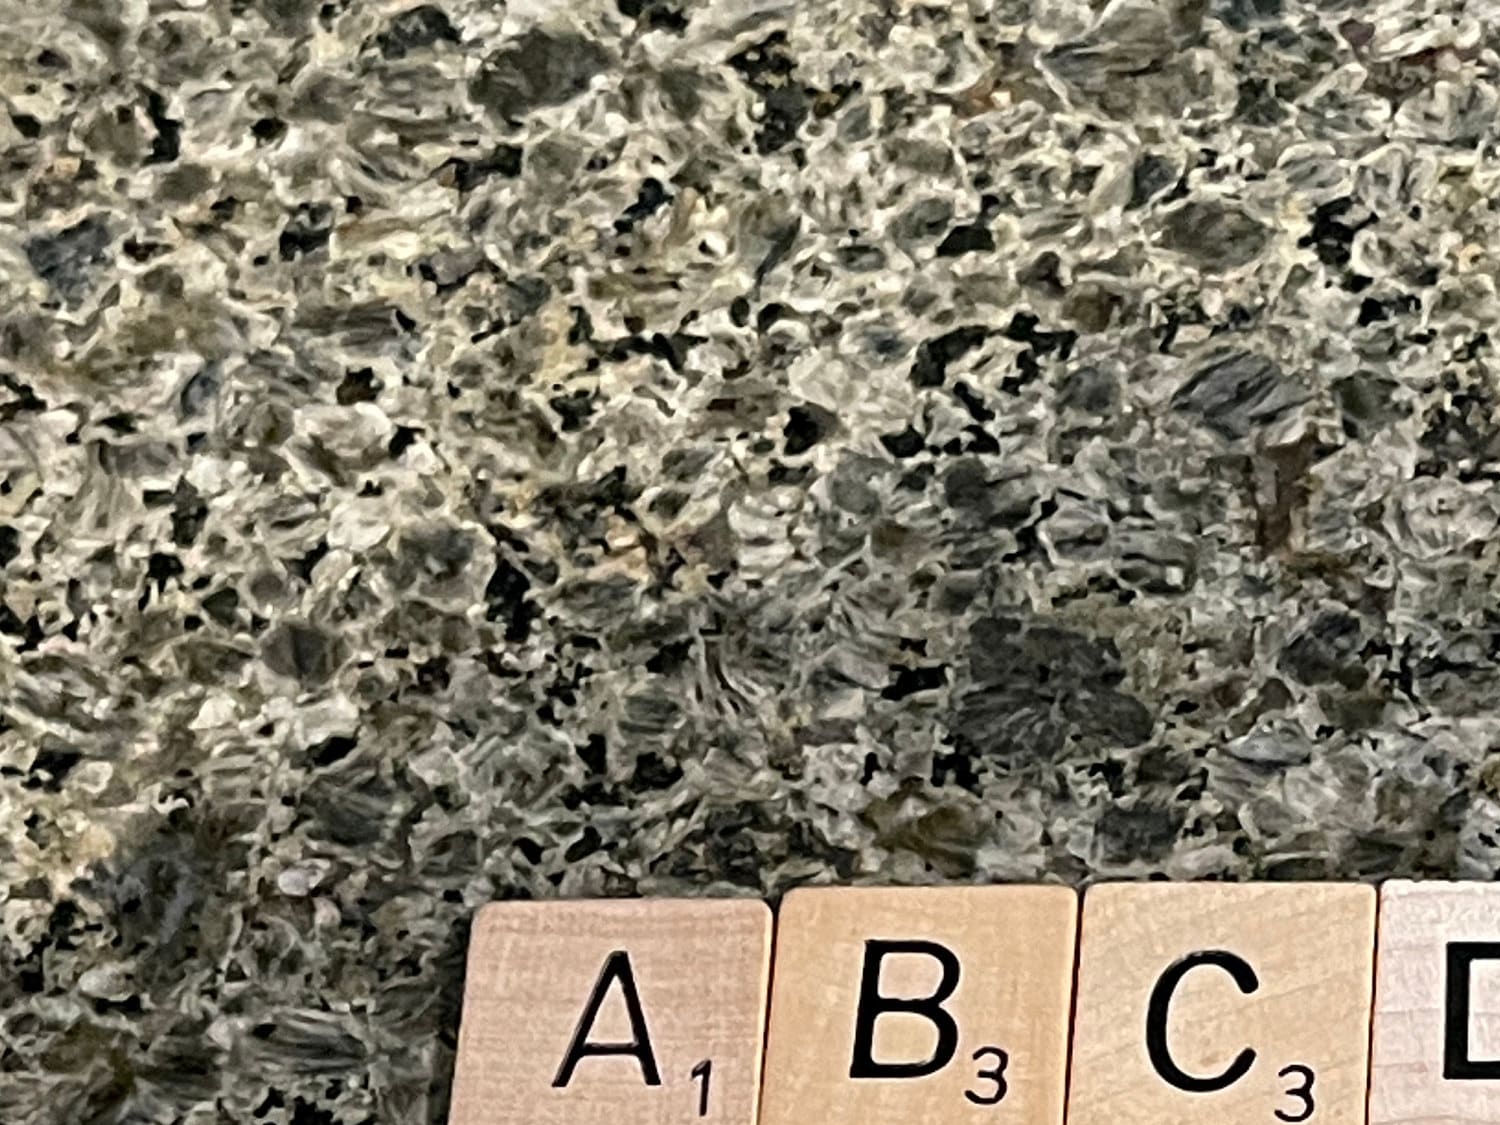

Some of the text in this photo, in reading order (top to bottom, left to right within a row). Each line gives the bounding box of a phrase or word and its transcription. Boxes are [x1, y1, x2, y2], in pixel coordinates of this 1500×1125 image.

[551, 950, 712, 1117] A 1
[849, 939, 1009, 1105] B 3
[1146, 950, 1315, 1123] C 3
